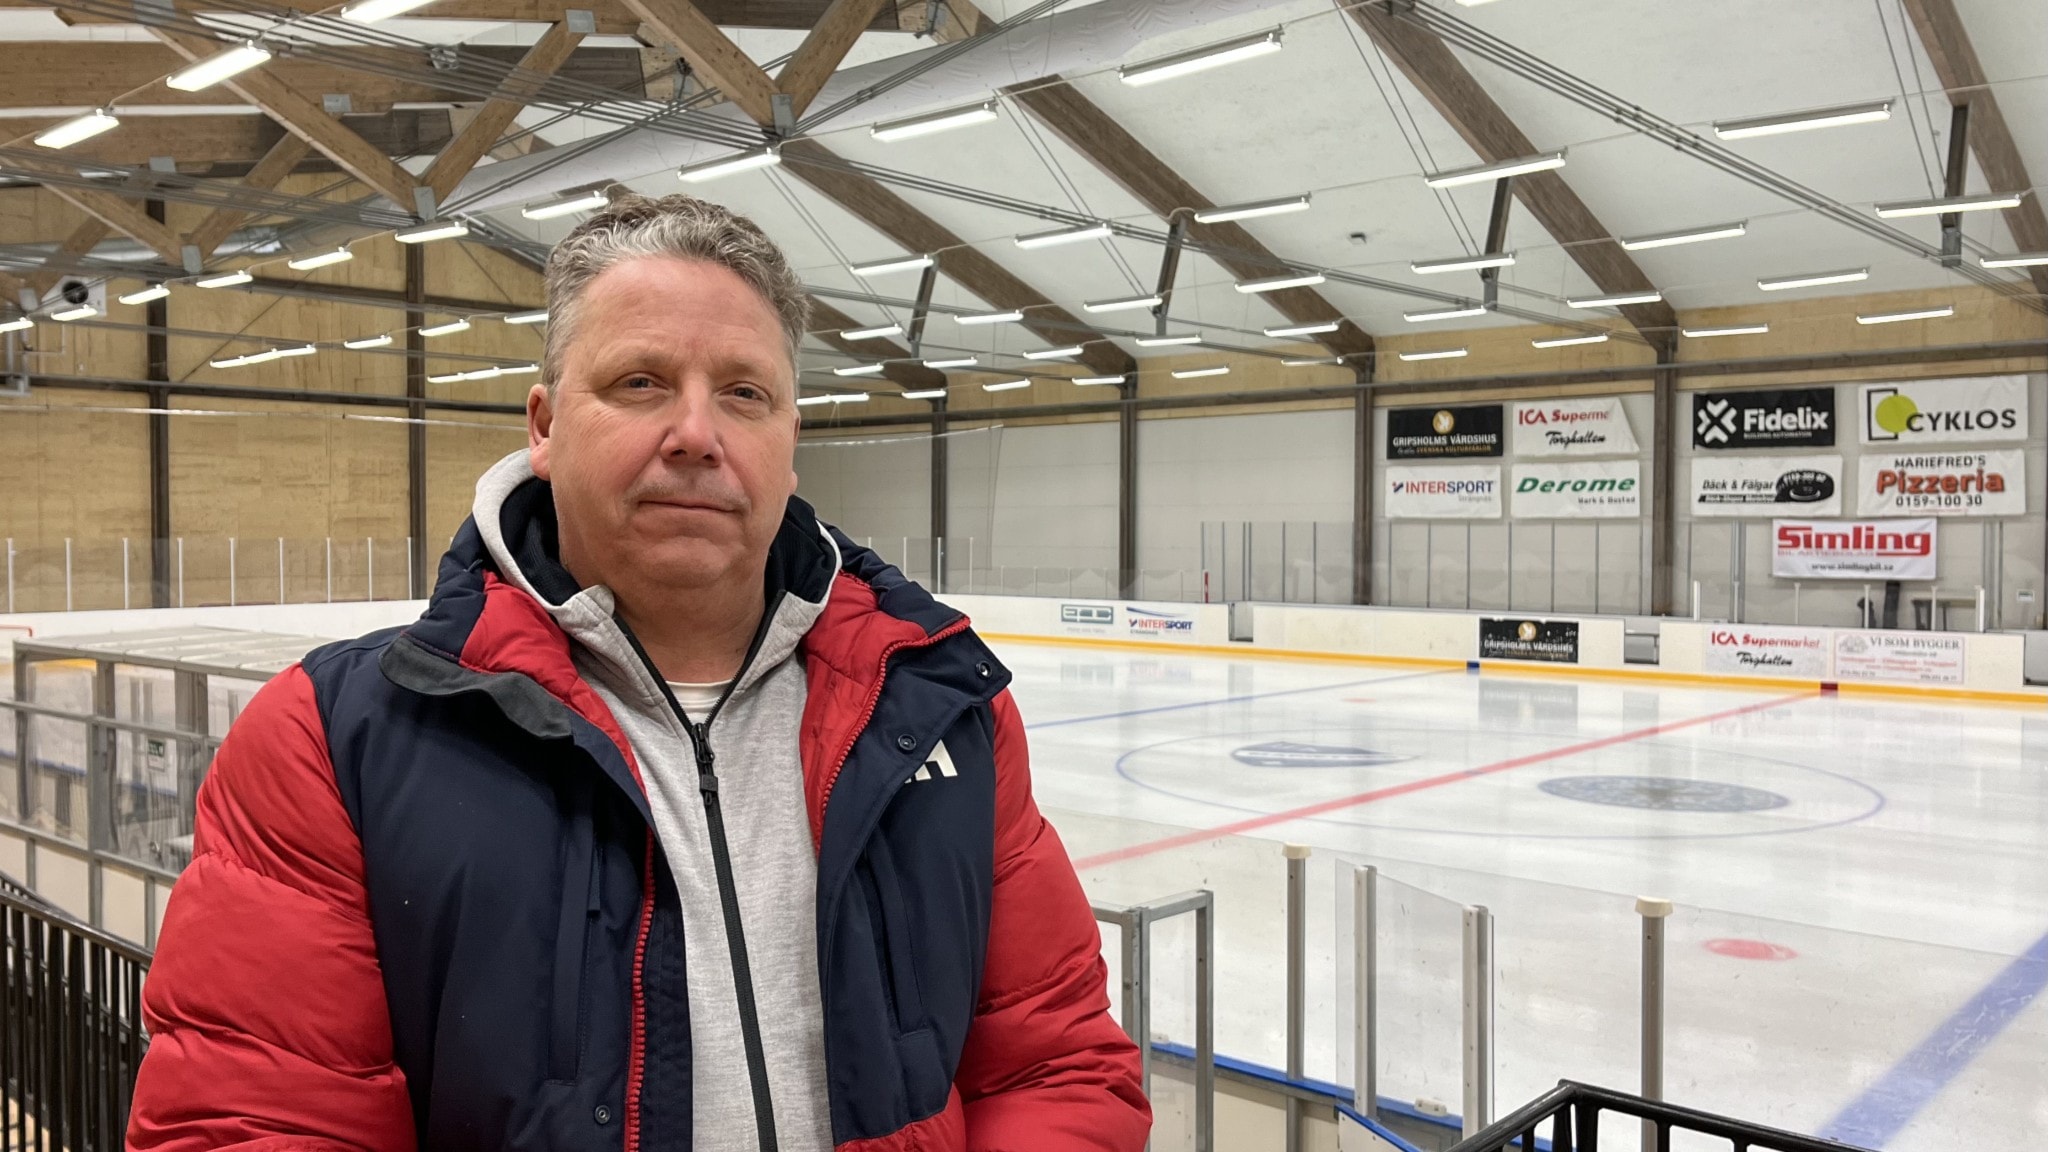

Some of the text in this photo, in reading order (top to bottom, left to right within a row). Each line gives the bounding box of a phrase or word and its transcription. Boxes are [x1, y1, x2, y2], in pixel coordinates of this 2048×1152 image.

[1519, 409, 1548, 425] ICA
[1743, 405, 1829, 431] Fidelix
[1905, 408, 2017, 432] CYKLOS
[1393, 435, 1448, 447] GRIPSHOLMS
[1545, 430, 1606, 448] Torghallen
[1894, 455, 1986, 468] MARIEFRED'S
[1405, 480, 1494, 494] INTERSPORT
[1516, 477, 1635, 493] Derome
[1702, 479, 1728, 490] Däck
[1731, 479, 1738, 490] &
[1876, 467, 2005, 495] Pizzeria
[1895, 494, 1983, 507] 0159-100 30
[1777, 526, 1931, 556] Simling
[1138, 618, 1193, 631] INTERSPORT
[1484, 639, 1531, 651] GRIPSHOLMS
[1711, 631, 1819, 649] ICA Supermarket
[1870, 636, 1960, 650] VI SOM BYGGER
[1736, 651, 1793, 668] Torghallen
